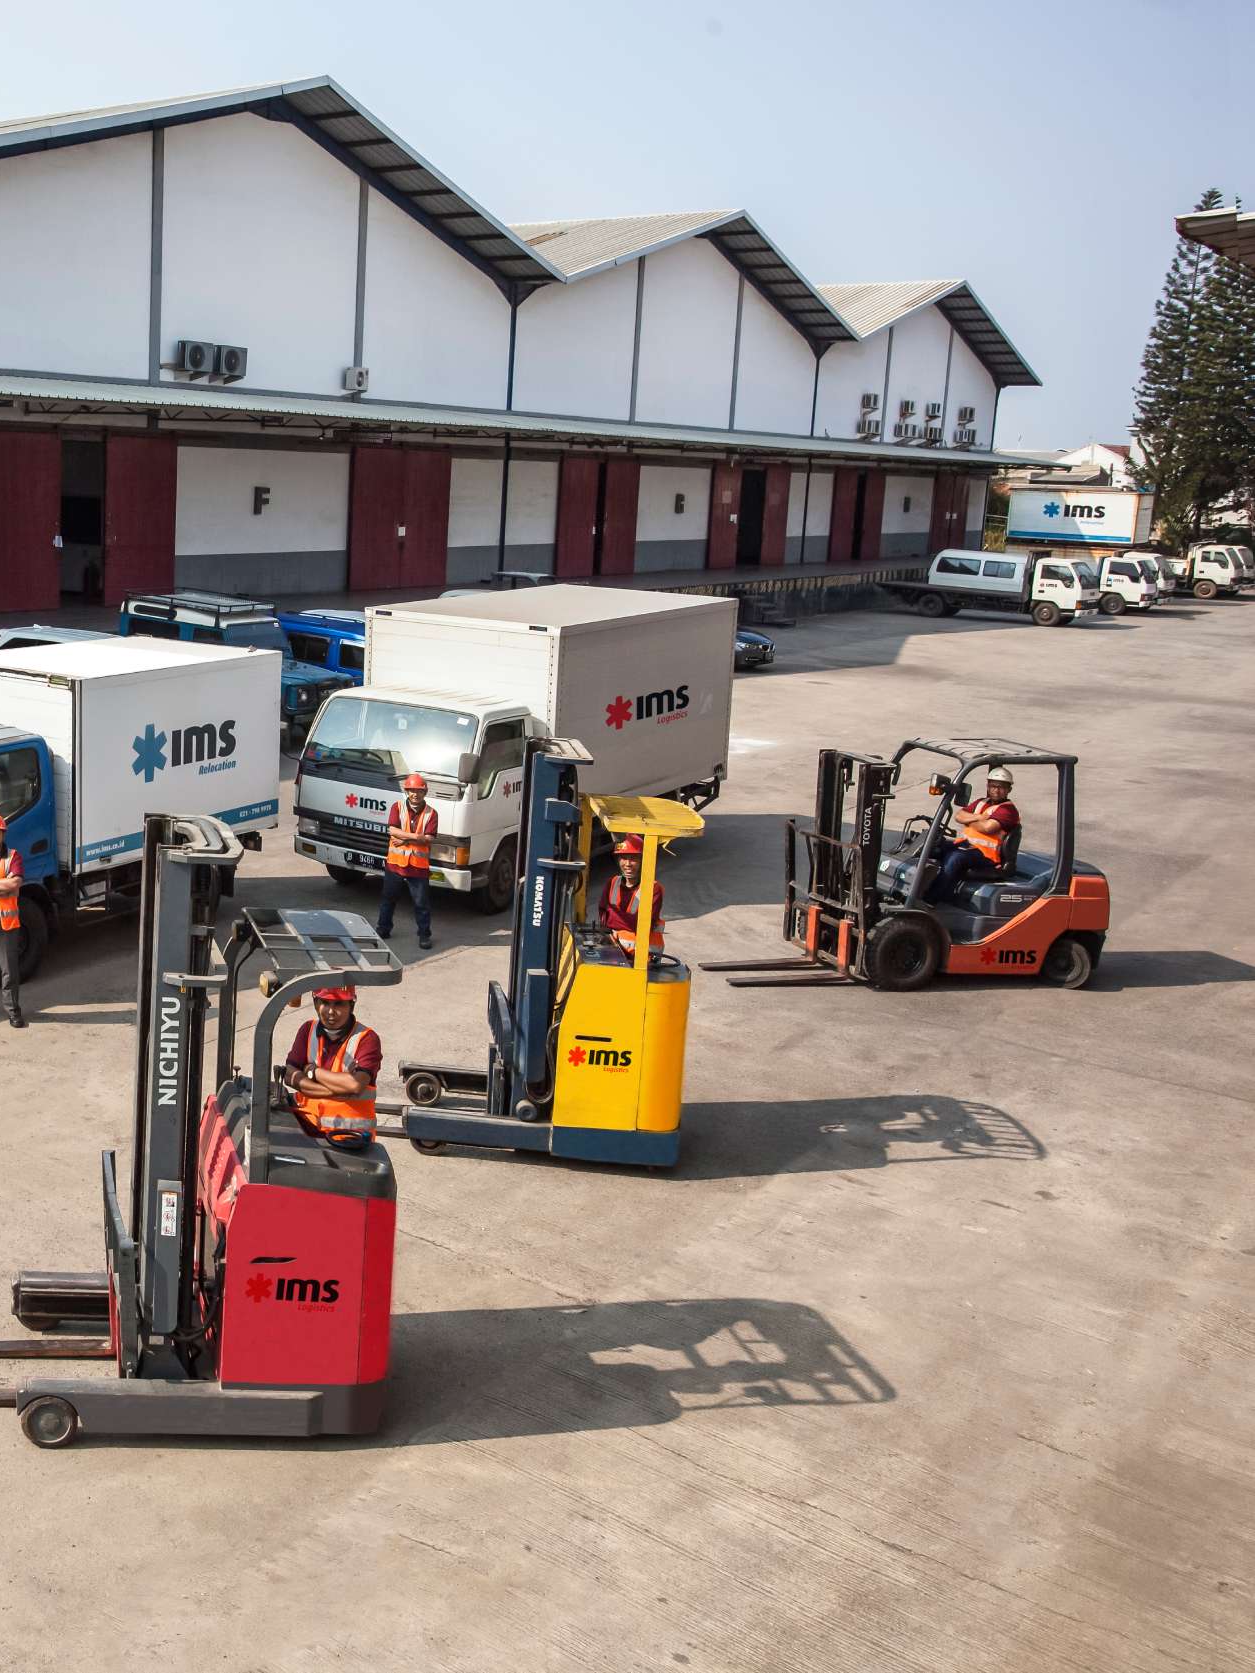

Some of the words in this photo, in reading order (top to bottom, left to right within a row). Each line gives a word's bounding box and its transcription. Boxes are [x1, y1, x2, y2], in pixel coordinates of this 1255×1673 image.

[254, 487, 270, 515] F
[656, 711, 689, 725] Logistics
[198, 760, 237, 775] Relocation
[862, 806, 873, 847] TOYOTA
[532, 875, 545, 927] KOMATSU
[999, 894, 1023, 903] 25
[158, 996, 181, 1106] NICHIYU
